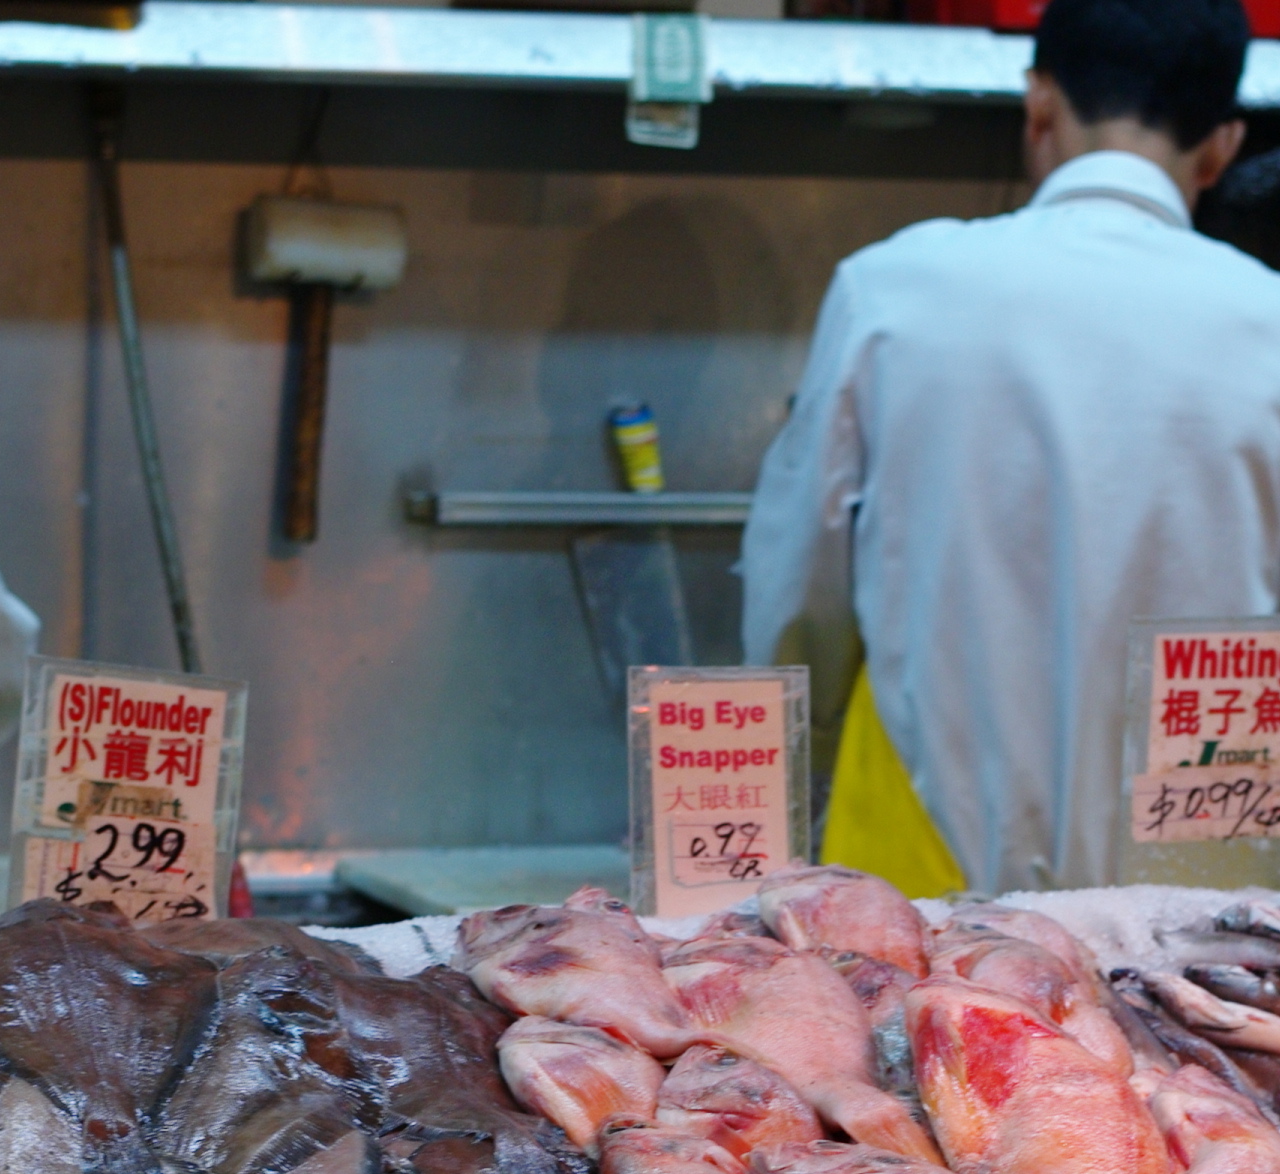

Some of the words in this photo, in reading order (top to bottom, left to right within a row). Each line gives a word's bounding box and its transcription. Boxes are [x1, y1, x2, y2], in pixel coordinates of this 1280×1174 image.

[58, 682, 213, 735] (S)Flounder
[659, 702, 705, 731] Big
[715, 701, 767, 731] Eye
[660, 745, 780, 774] Snapper
[663, 783, 769, 813] 大眼紅
[87, 823, 186, 887] 2.99
[690, 822, 762, 858] 0.99
